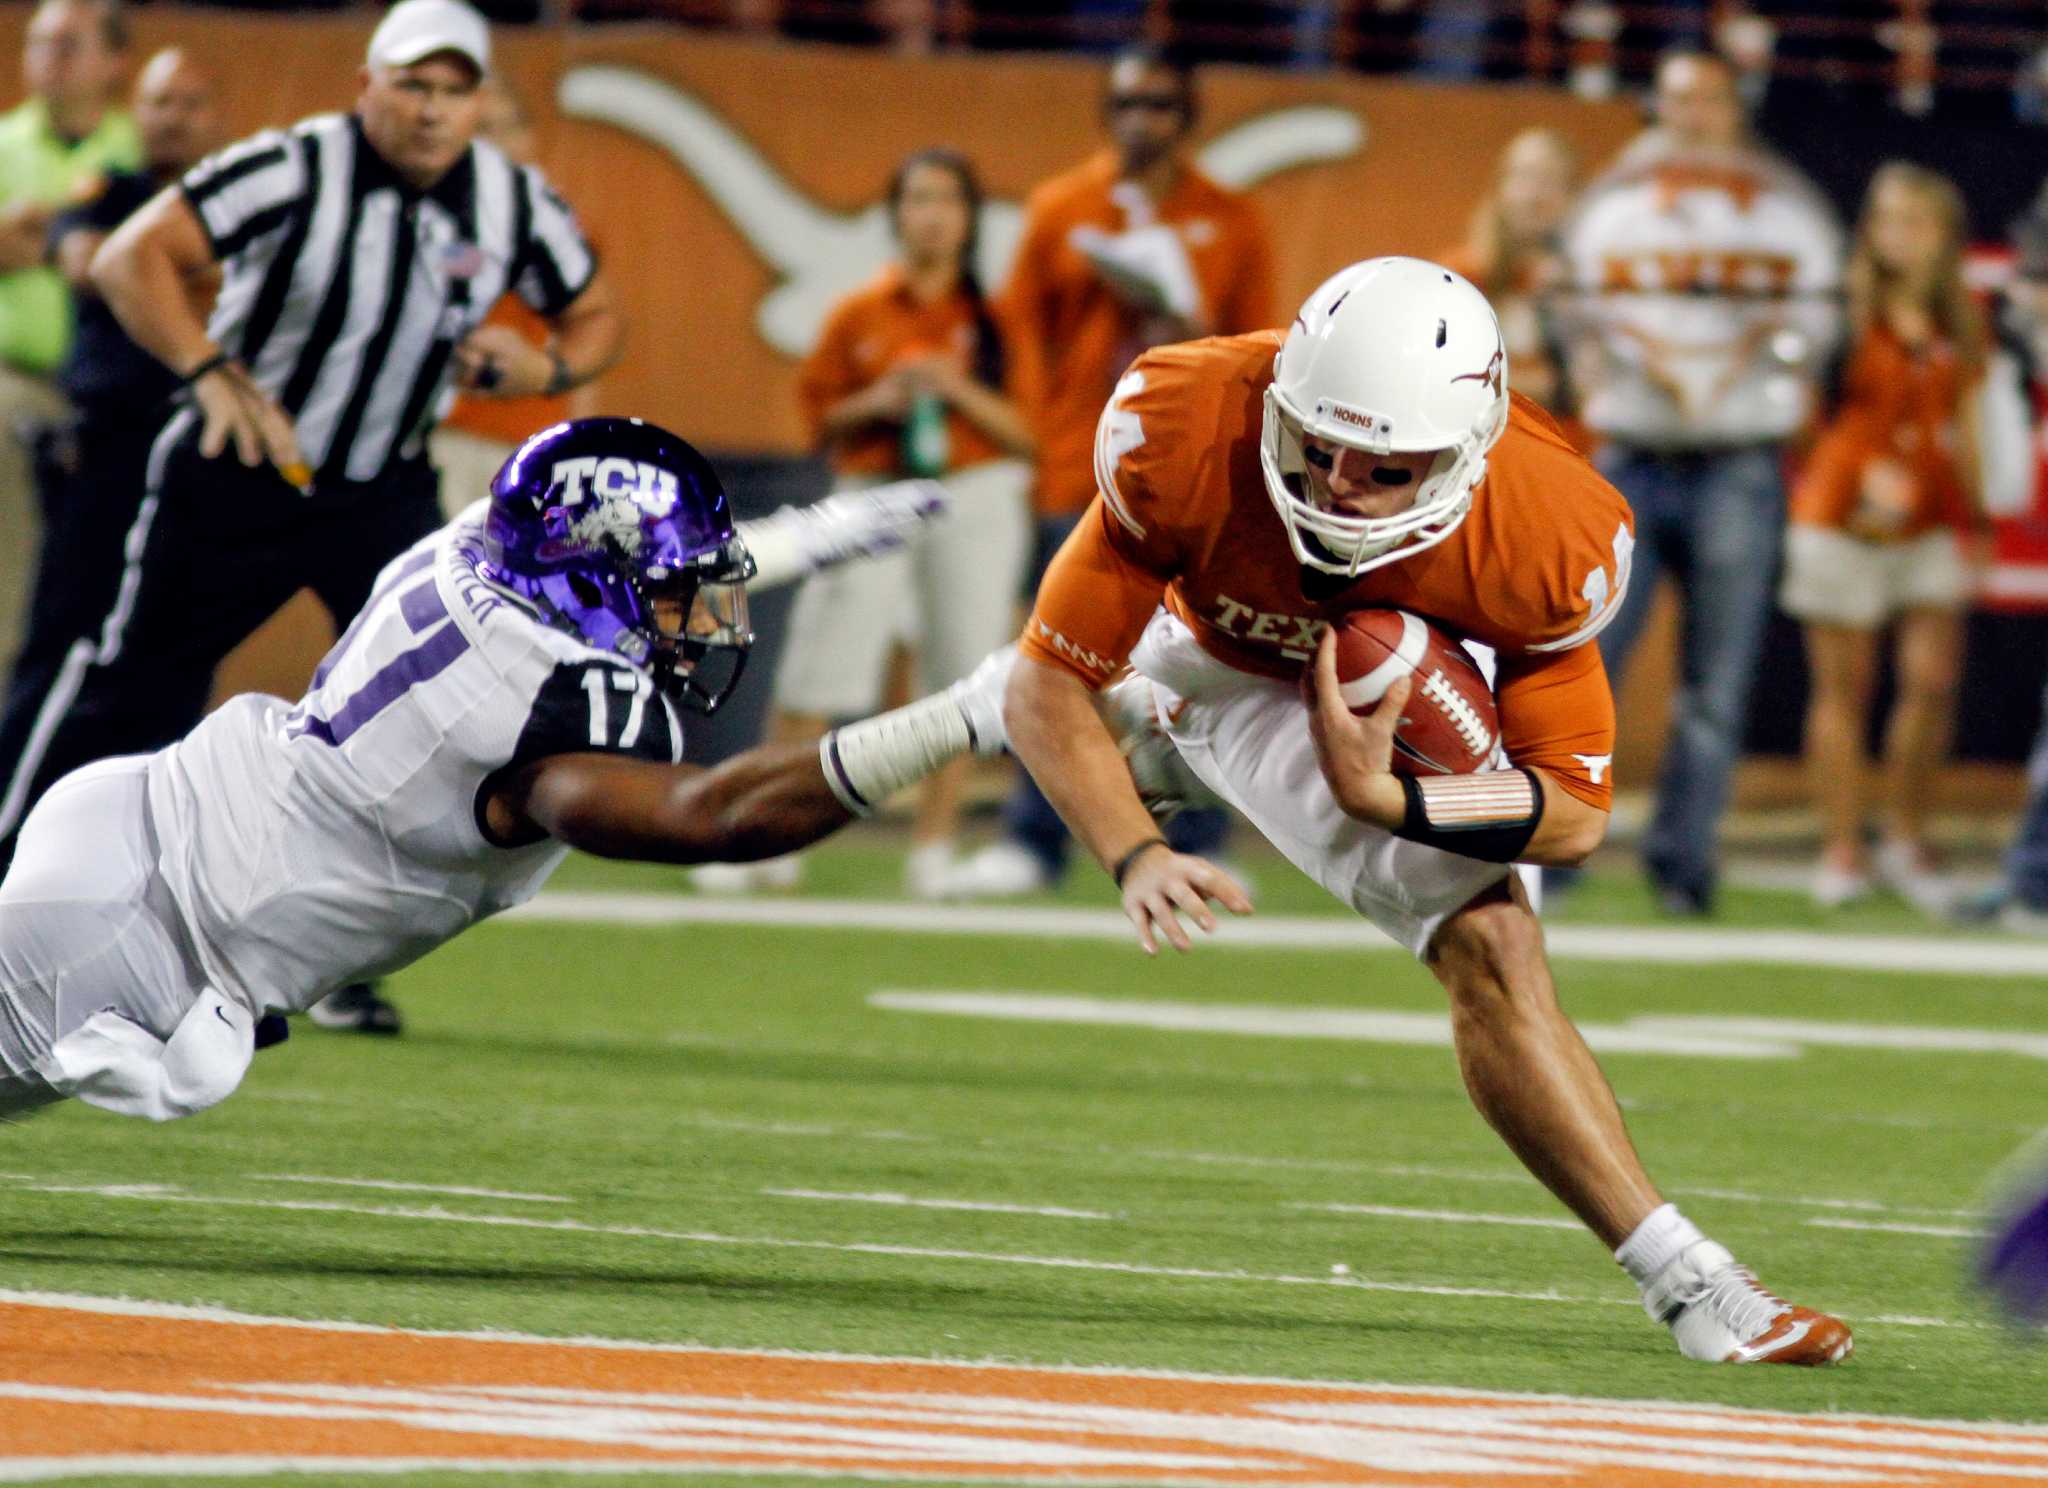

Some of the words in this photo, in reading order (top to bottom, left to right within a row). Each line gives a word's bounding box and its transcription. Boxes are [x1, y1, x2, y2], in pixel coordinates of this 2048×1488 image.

[1333, 405, 1373, 429] HORNS
[551, 456, 679, 518] TCU
[1216, 593, 1330, 649] TEX
[581, 668, 653, 748] 17
